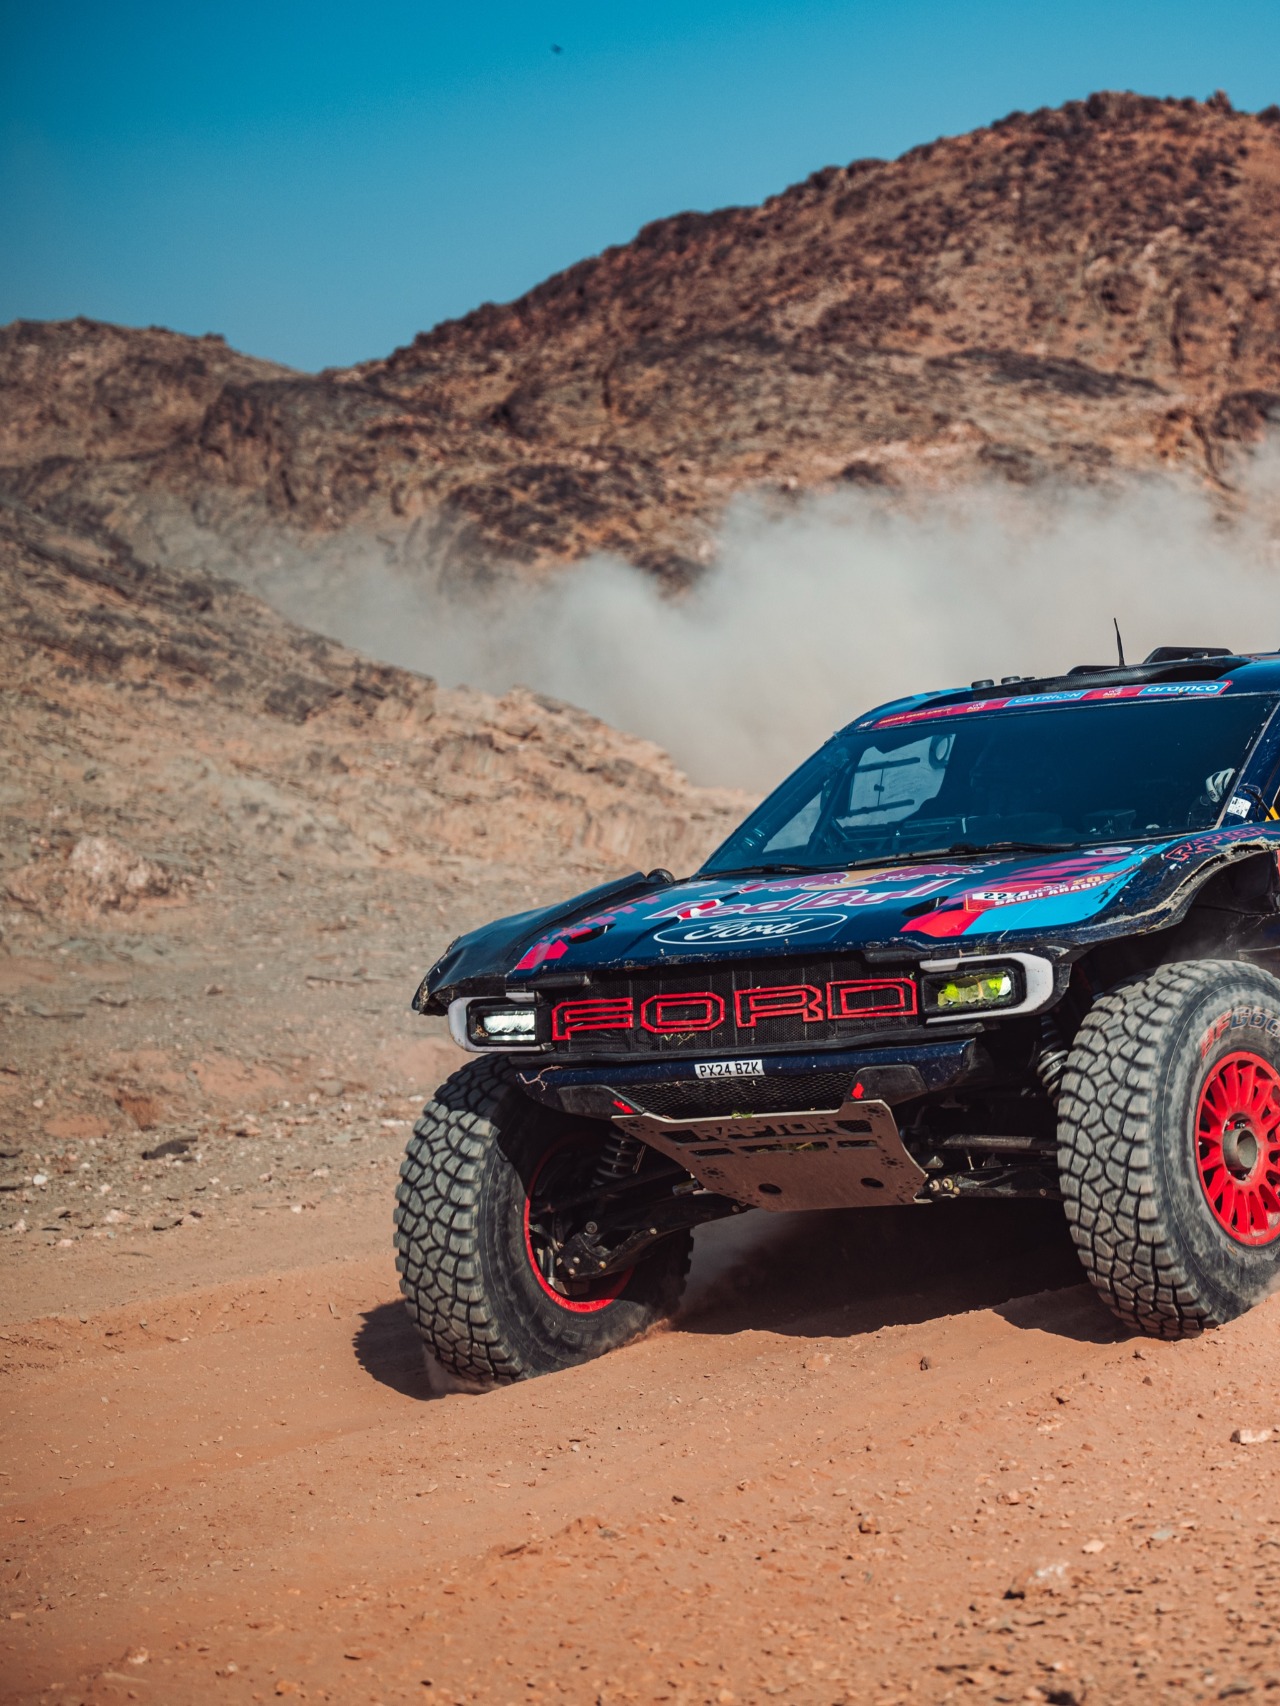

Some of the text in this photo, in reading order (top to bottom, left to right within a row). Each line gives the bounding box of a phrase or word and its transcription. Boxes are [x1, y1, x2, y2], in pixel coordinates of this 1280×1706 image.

[995, 891, 1043, 906] SAUDI
[684, 916, 815, 941] Ford
[552, 978, 917, 1041] FORD
[699, 1061, 760, 1077] PX24 BZK
